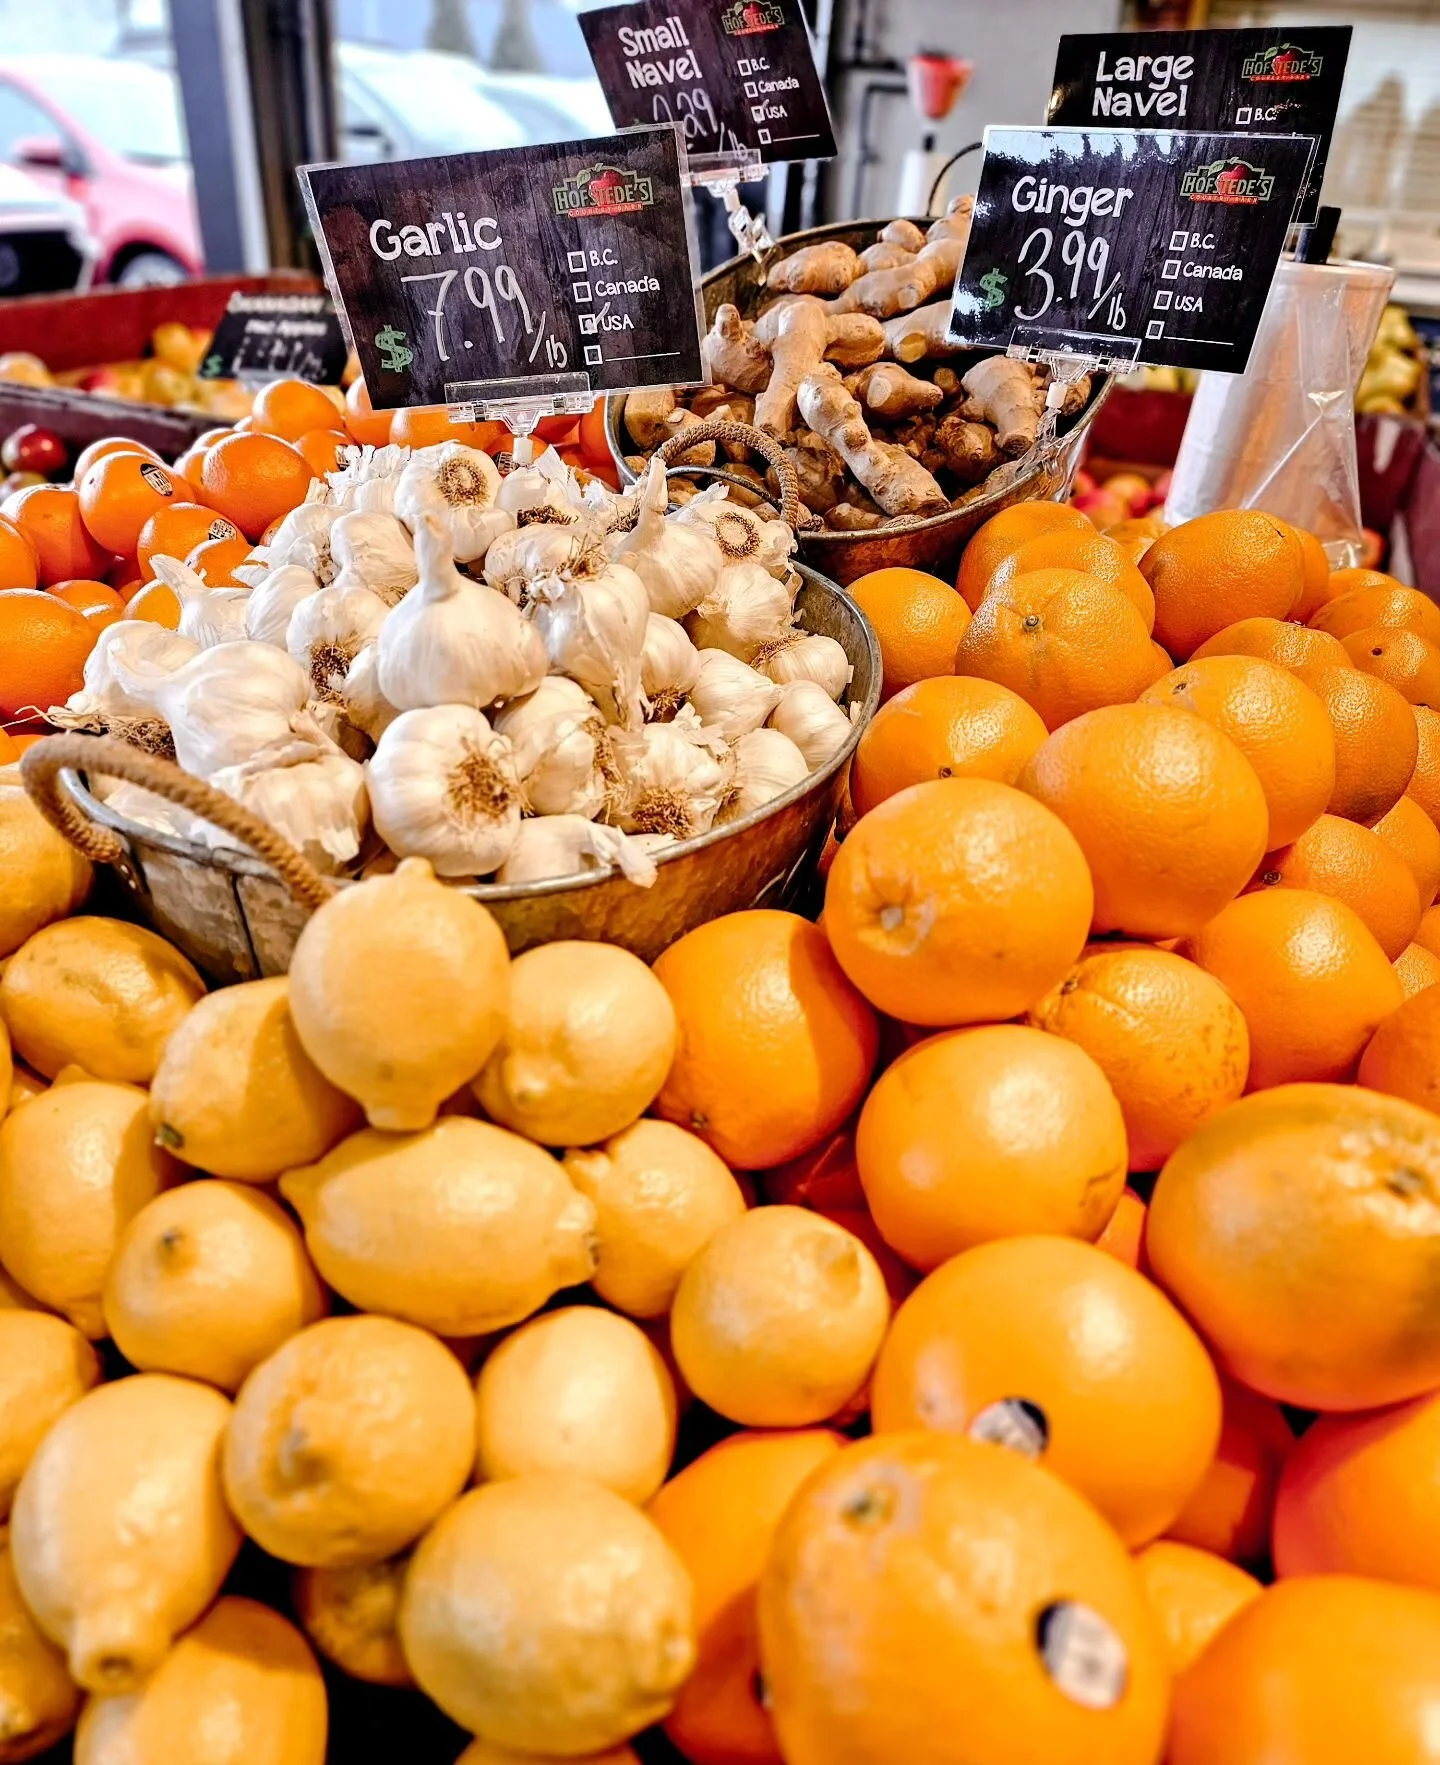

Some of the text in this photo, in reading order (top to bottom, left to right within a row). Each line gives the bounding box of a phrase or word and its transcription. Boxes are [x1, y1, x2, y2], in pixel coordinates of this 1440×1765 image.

[618, 16, 690, 57] Small
[625, 49, 703, 88] Navel
[751, 57, 770, 71] B.C.
[1096, 51, 1195, 91] Large
[758, 77, 800, 93] Canada
[1092, 84, 1188, 116] Navel
[765, 105, 788, 119] USA
[1184, 176, 1270, 196] HOFSTEDE'S
[556, 182, 650, 211] HOFSTEDE'S
[1011, 175, 1135, 227] Ginger
[369, 211, 503, 261] Garlic
[1190, 232, 1216, 249] B.C.
[589, 248, 618, 266] B.C.
[1182, 261, 1243, 281] Canada
[595, 276, 661, 297] Canada
[1174, 295, 1203, 313] USA
[602, 313, 635, 331] USA
